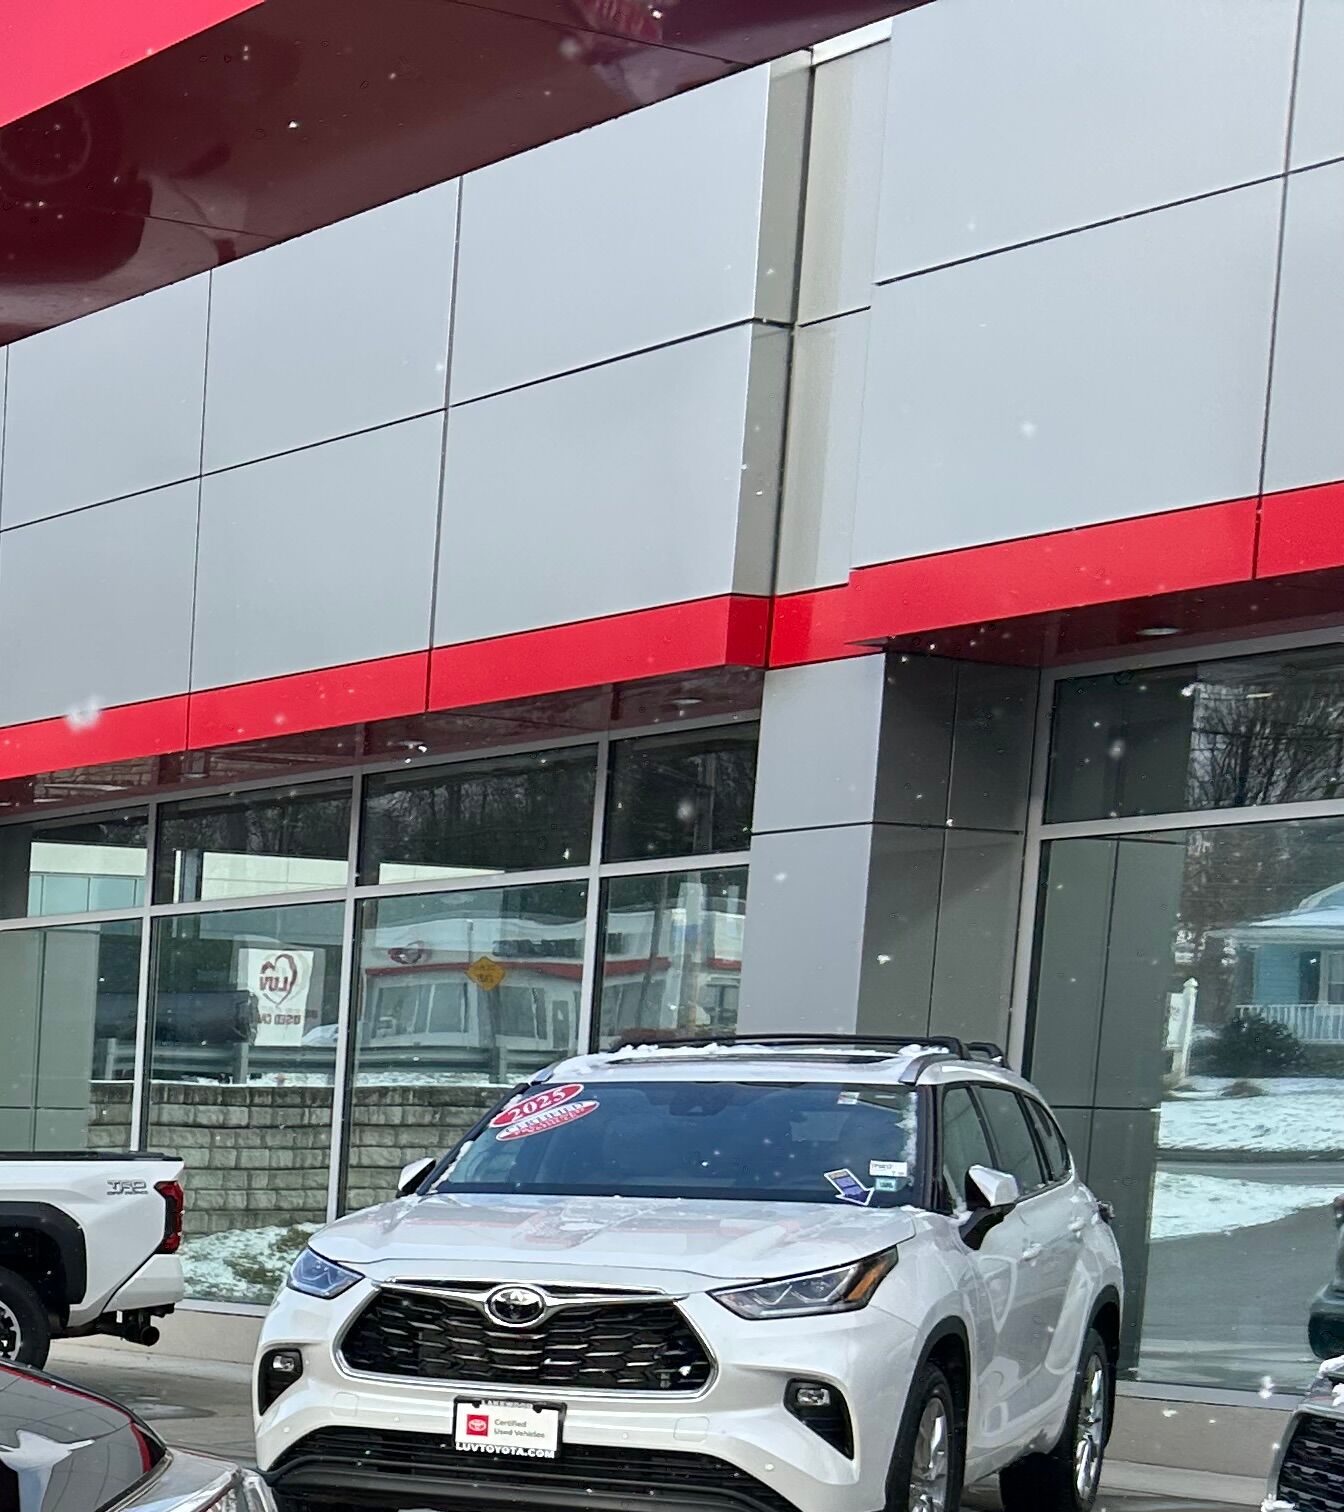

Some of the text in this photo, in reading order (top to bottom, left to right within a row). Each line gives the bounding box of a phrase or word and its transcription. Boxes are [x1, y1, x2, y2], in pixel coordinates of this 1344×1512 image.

[508, 1087, 567, 1121] 2025
[493, 1427, 513, 1436] Used
[455, 1441, 555, 1459] LUVTOYOTA.COM
